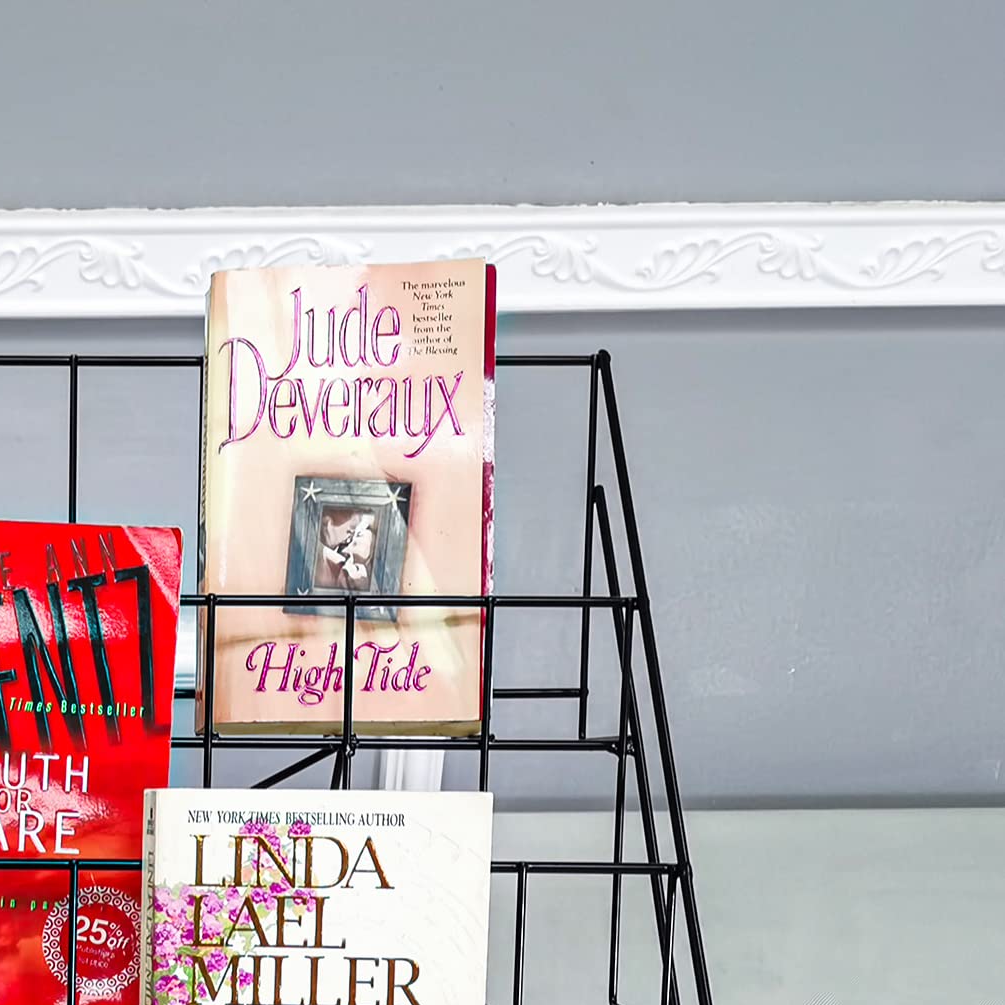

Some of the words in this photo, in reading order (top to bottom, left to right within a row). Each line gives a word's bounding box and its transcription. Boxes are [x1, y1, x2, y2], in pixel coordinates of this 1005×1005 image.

[402, 281, 419, 291] The
[421, 277, 466, 290] marvelous
[412, 291, 433, 301] New
[435, 289, 453, 299] York
[421, 302, 445, 311] Times
[412, 312, 452, 322] bestseller
[267, 283, 401, 380] Jude
[413, 324, 434, 333] from
[436, 323, 451, 332] the
[443, 334, 452, 343] of
[425, 346, 458, 356] Blessing
[218, 337, 465, 458] Deveraux
[45, 532, 118, 582] ANN
[246, 641, 345, 706] High
[353, 639, 432, 692] Tide
[9, 697, 52, 713] Times
[61, 700, 145, 718] Bestseller
[188, 810, 212, 824] NEW
[217, 810, 246, 825] YORK
[247, 811, 280, 825] TIMES
[285, 811, 355, 827] BESTSELLING
[358, 813, 405, 827] AUTHOR
[188, 834, 395, 889] LINDA
[0, 896, 15, 908] in
[188, 894, 346, 949] LAEL
[107, 937, 130, 951] off
